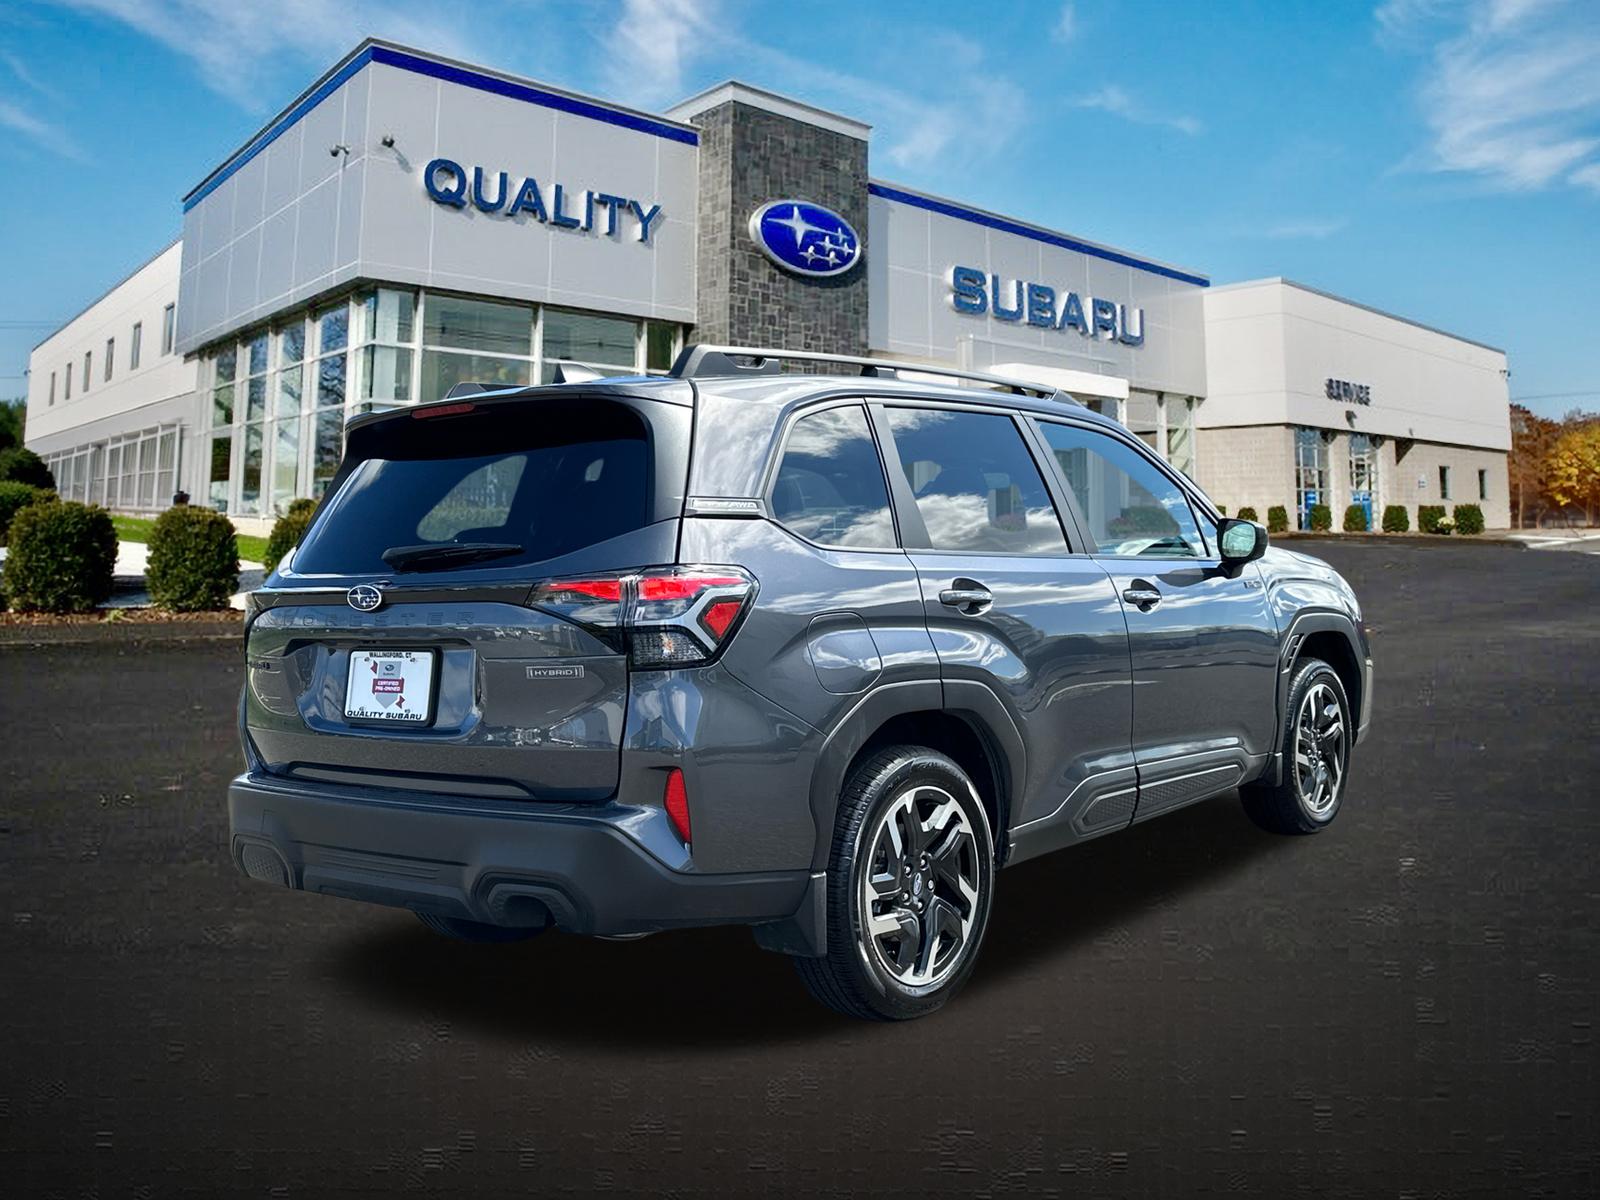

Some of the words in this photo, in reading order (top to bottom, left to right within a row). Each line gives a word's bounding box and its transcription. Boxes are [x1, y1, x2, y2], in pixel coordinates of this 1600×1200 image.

[424, 158, 662, 242] QUALITY
[950, 265, 1145, 346] SUBARU
[1324, 378, 1370, 406] SERVICE
[346, 710, 384, 718] QUALITY
[385, 712, 422, 720] SUBARU
